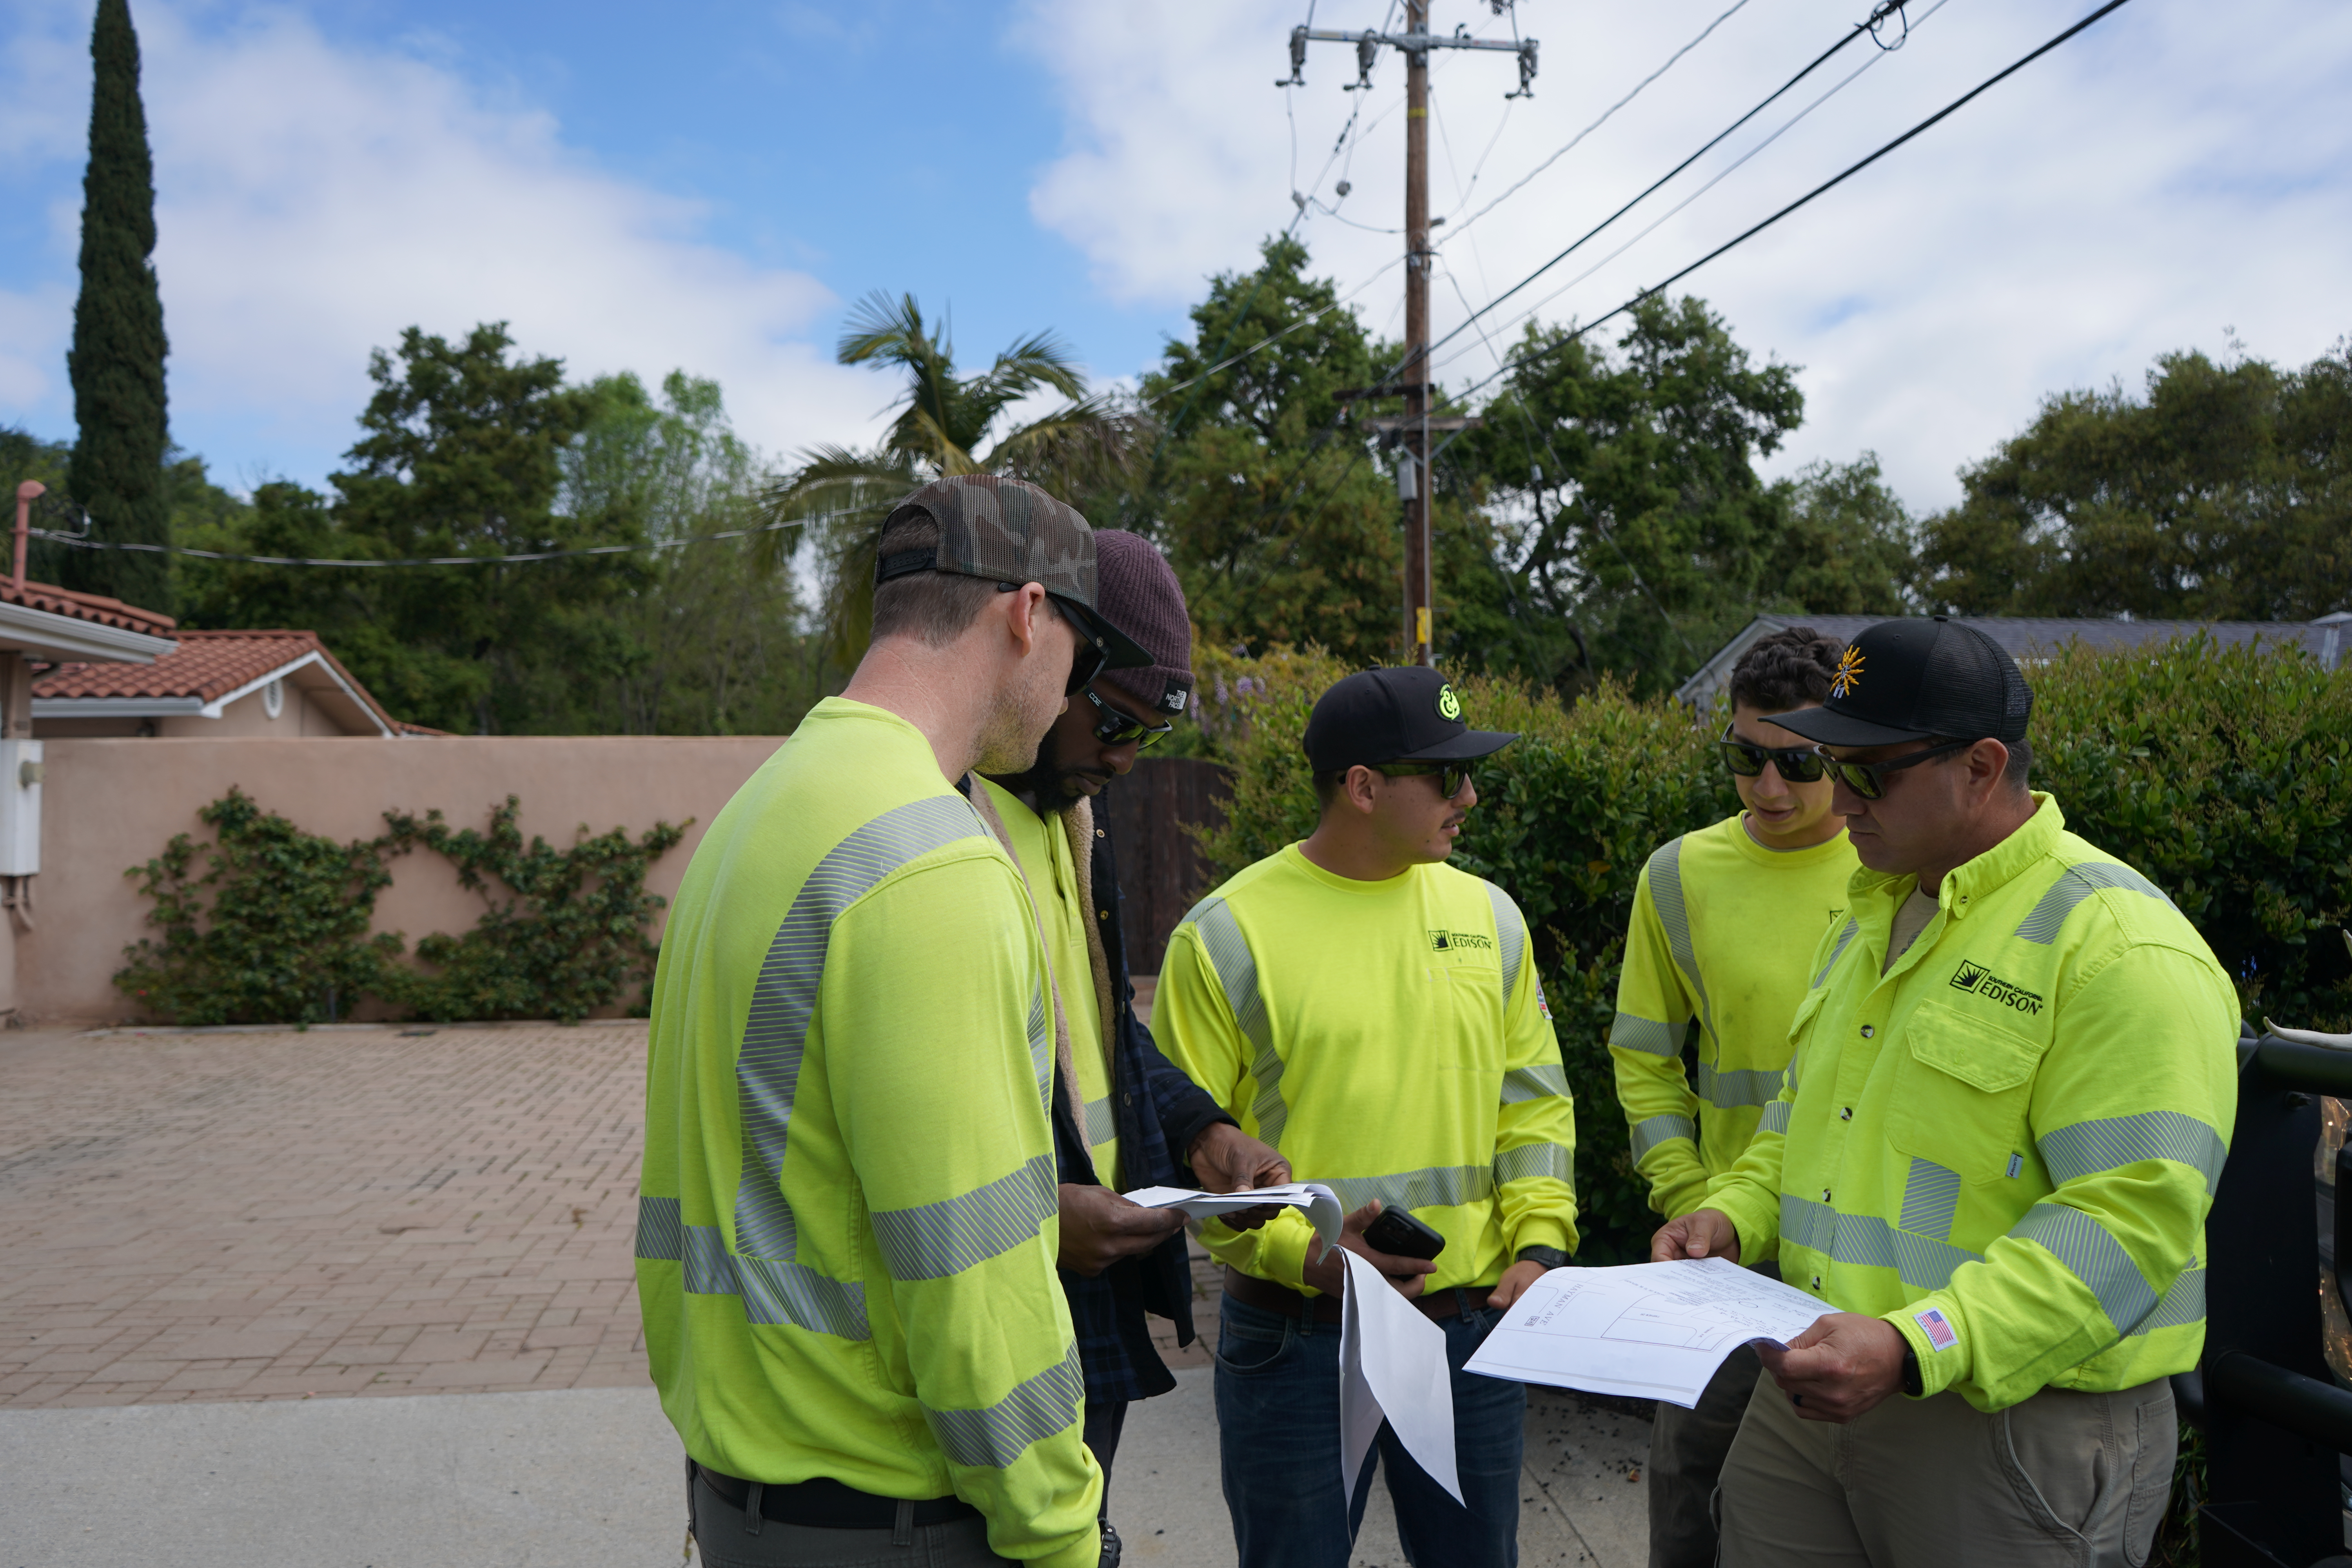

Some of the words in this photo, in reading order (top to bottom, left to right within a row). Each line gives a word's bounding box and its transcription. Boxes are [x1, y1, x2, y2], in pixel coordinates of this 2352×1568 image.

[1165, 693, 1181, 703] NORTH
[1453, 937, 1491, 949] EDISON
[1988, 976, 2014, 990] SOUTHERN
[1979, 981, 2041, 1016] EDISON
[1554, 1283, 1584, 1308] HAYMAN
[1540, 1311, 1554, 1325] AVE
